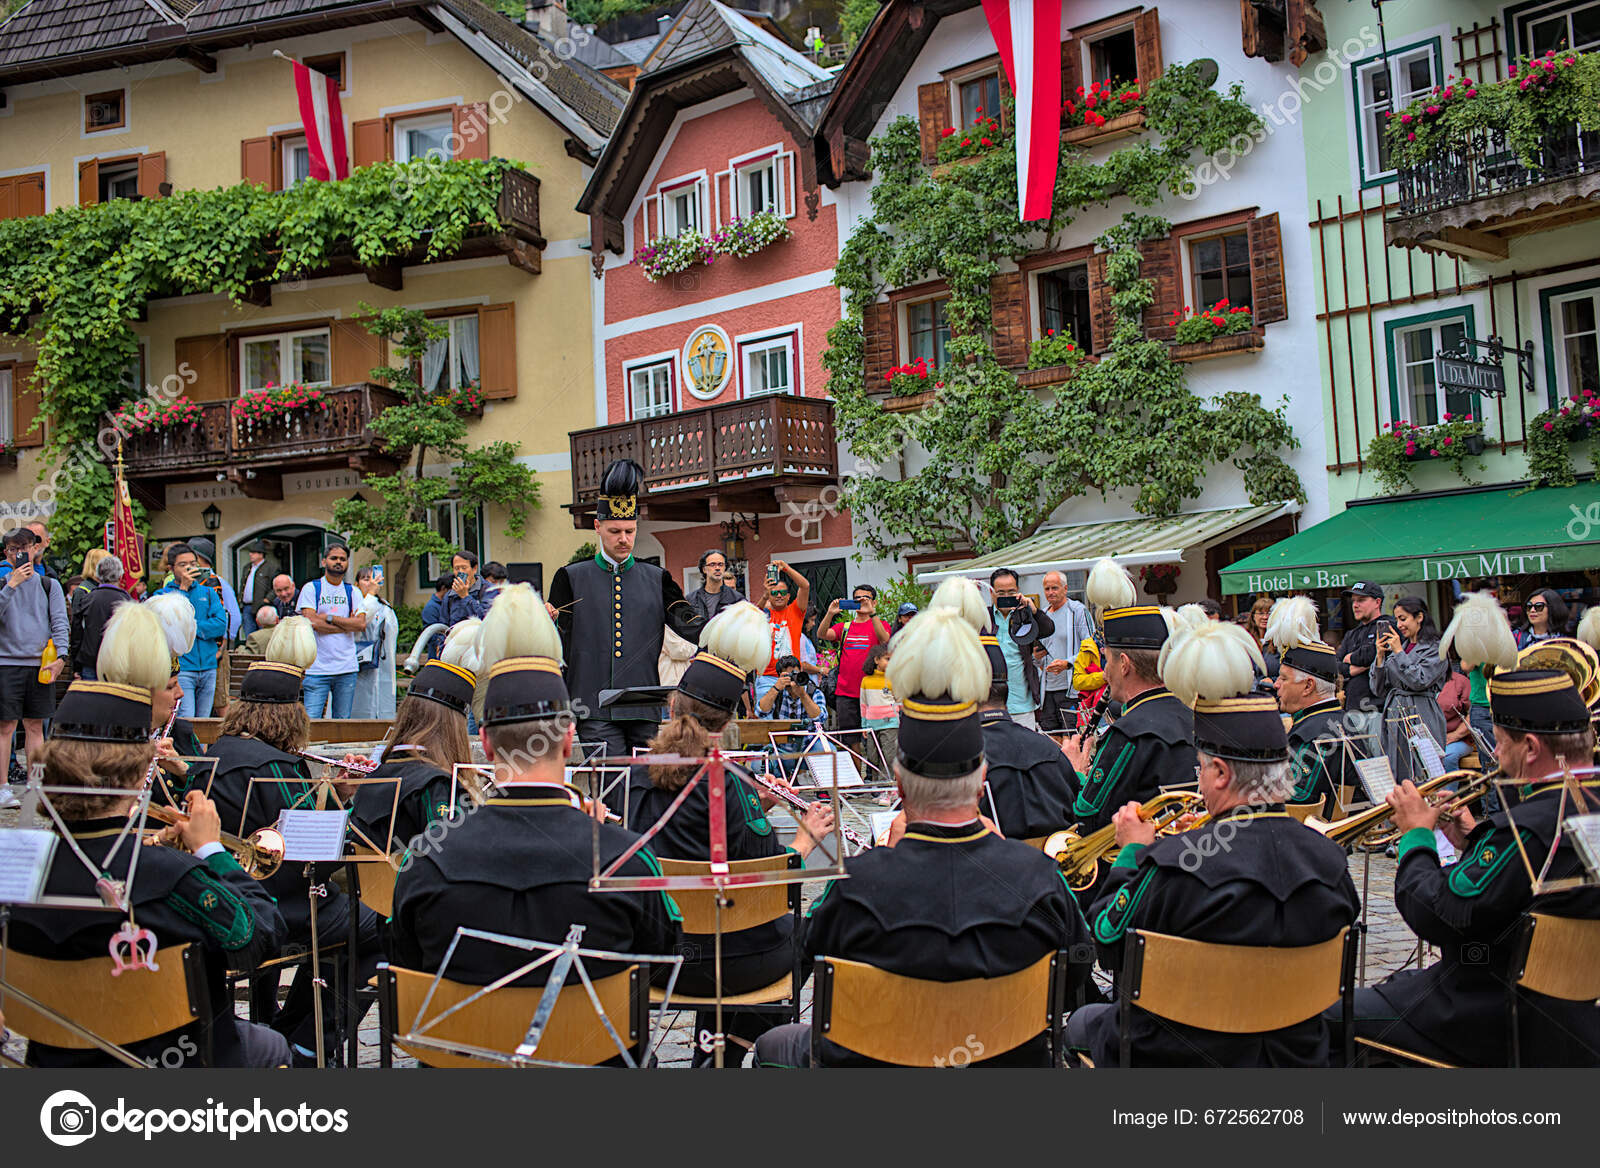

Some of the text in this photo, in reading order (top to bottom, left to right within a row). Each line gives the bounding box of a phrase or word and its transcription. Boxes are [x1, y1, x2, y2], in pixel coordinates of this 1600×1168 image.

[1466, 364, 1498, 388] MITT
[183, 488, 243, 500] ANDENK
[296, 475, 358, 490] SOUVENI
[1422, 552, 1554, 581] IDA MITT
[1248, 572, 1294, 593] Hotel
[1316, 570, 1348, 588] Bar
